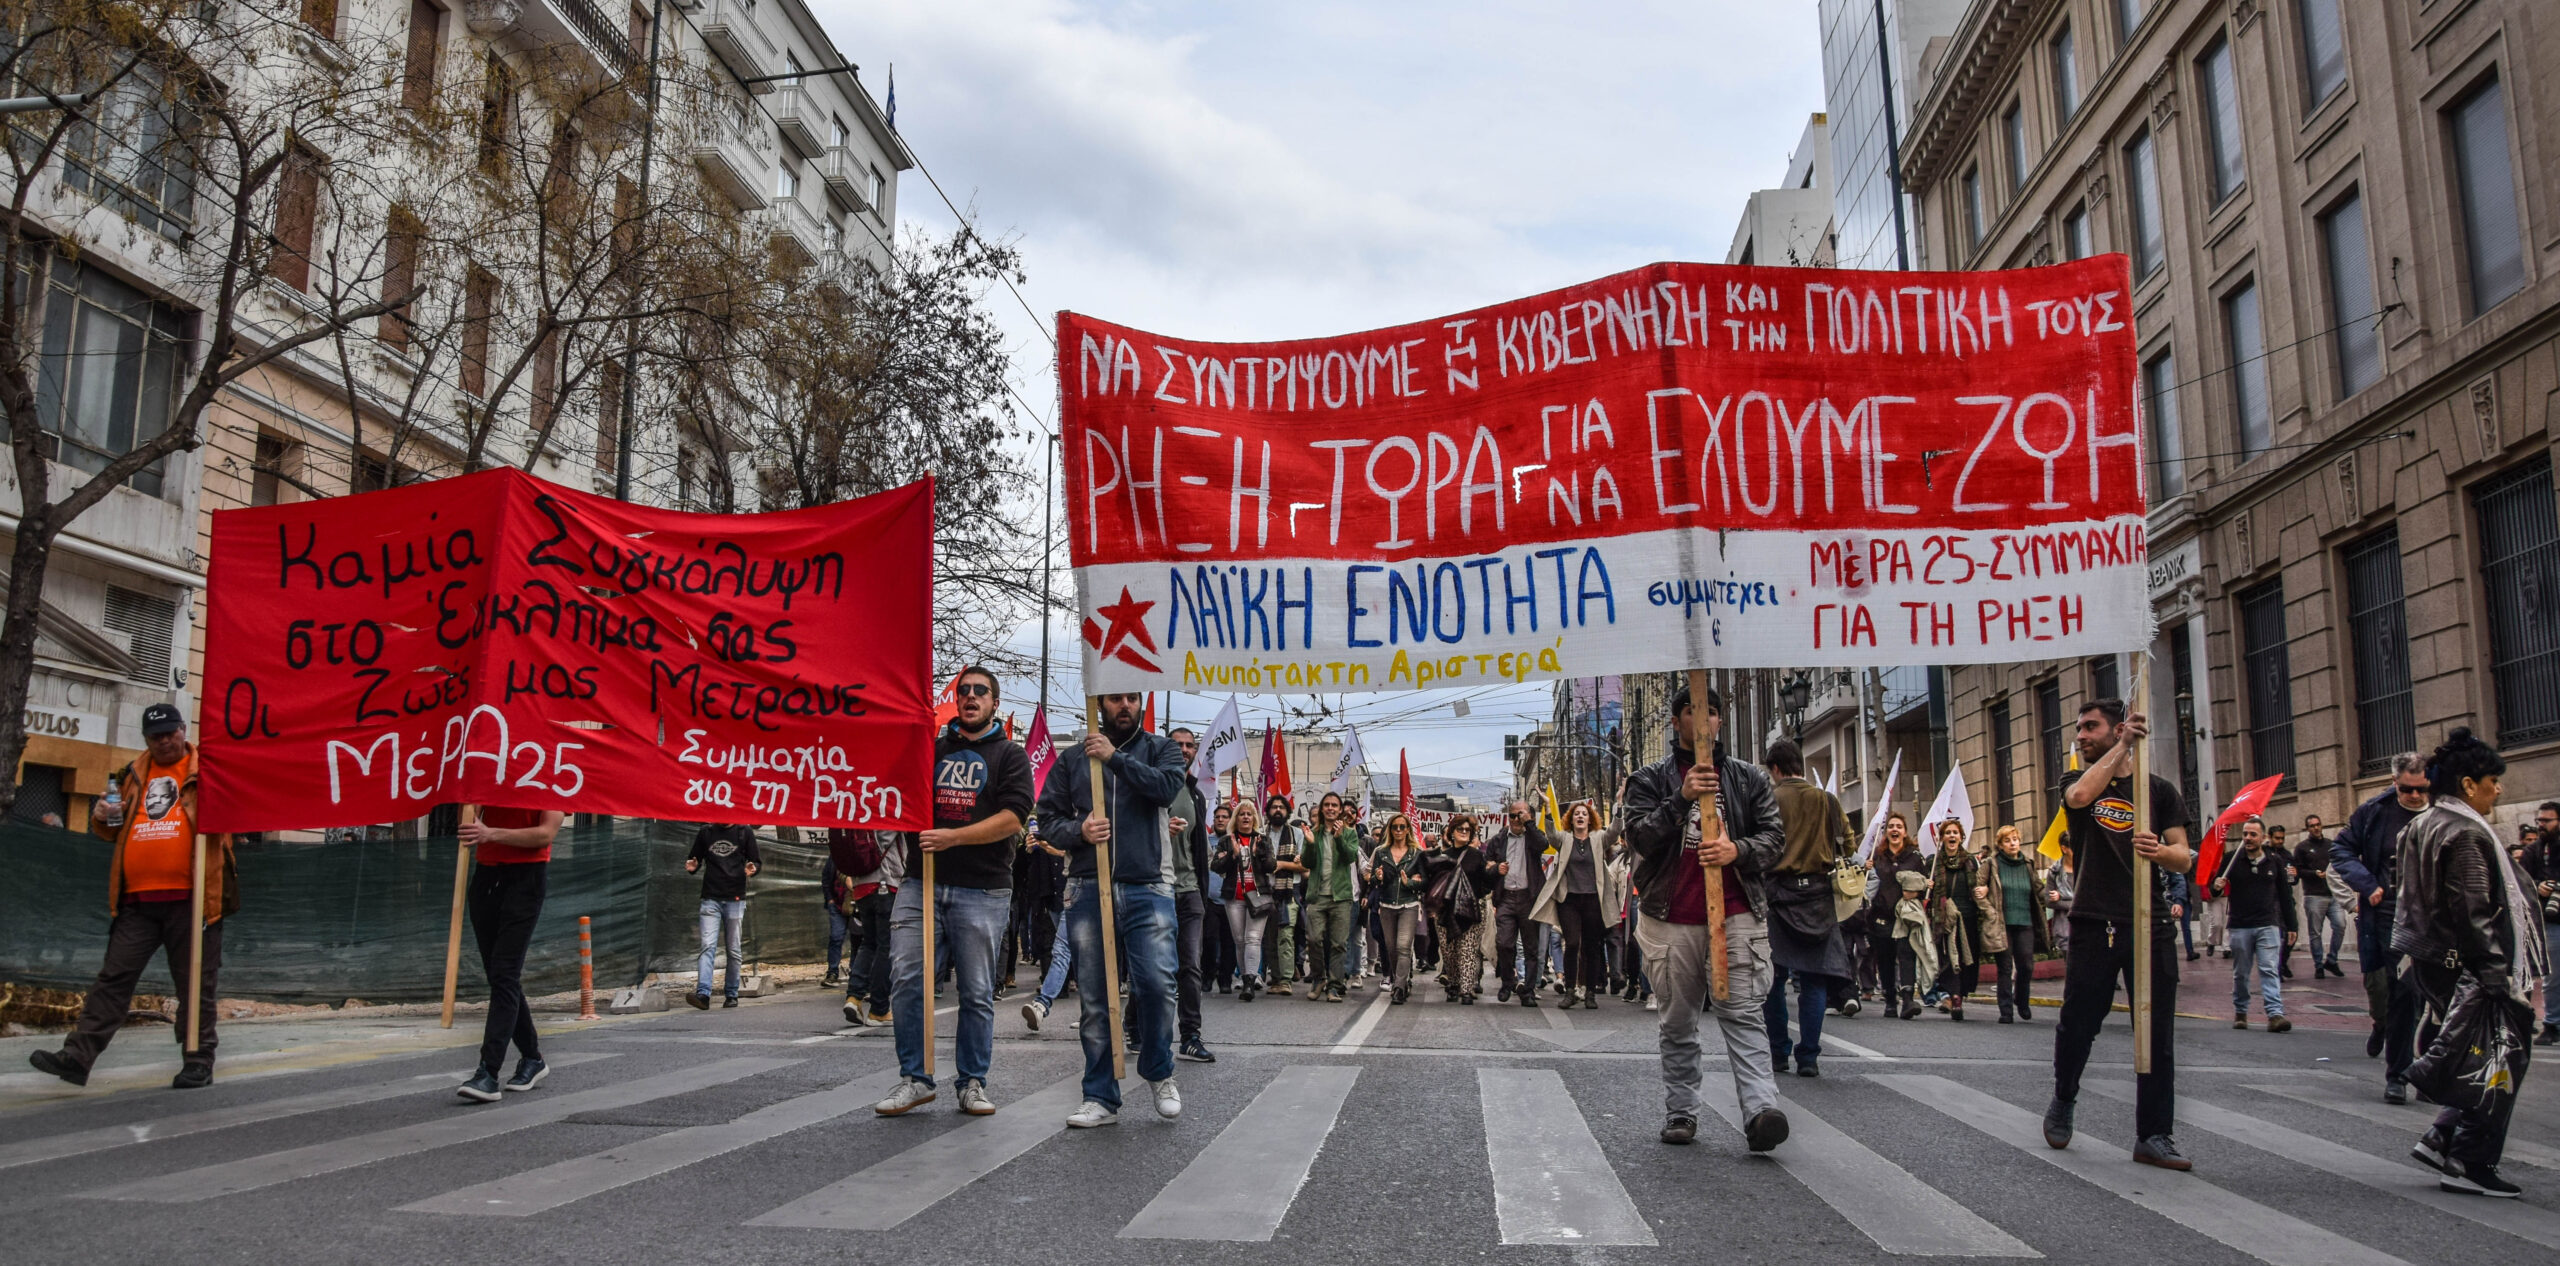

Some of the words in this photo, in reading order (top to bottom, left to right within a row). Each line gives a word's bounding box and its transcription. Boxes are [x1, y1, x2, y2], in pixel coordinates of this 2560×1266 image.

[1725, 280, 1779, 313] ΚΑΙ
[1806, 282, 2013, 358] ΠΟΛΙΤΙΚΗ
[2025, 291, 2125, 339] ΤΟΥΣ
[1443, 318, 1480, 394] ΤΗΝ
[1497, 281, 1708, 378] ΚΥΒΕΡΝΗΣΗ
[1723, 319, 1787, 352] ΤΗΝ
[1081, 330, 1141, 399] ΝΑ
[1154, 338, 1426, 412] ΣΥΝΤΡΙΨΟΥΜΕ
[1541, 397, 1614, 461] ΓΙΑ
[1645, 387, 1919, 517] ΕΧΟΥΜΕ
[1952, 375, 2144, 513] ΖΩΗ
[1086, 425, 1272, 555] ΡΗΞΗ
[1309, 425, 1505, 550] ΤΩΡΑ
[1547, 466, 1624, 527] ΝΑ
[278, 512, 484, 599] Καμία
[527, 494, 845, 611] Συγκάλυψη
[2154, 554, 2186, 588] BANK
[1167, 564, 1313, 652] ΛΑΪΚΗ
[1346, 545, 1616, 649] ΕΝΟΤΗΤΑ
[1813, 603, 1877, 649] ΓΙΑ
[1900, 600, 1954, 646] ΤΗ
[1978, 594, 2083, 645] ΡΗΞΗ
[286, 618, 384, 669] στο
[705, 611, 797, 664] σας
[1183, 650, 1370, 689] Ανυπότακτη
[1388, 636, 1564, 690] Αριστερά
[224, 676, 281, 741] Οι
[352, 667, 471, 723] Ζωές
[504, 660, 599, 704] μας
[650, 659, 868, 732] Μετράνε
[678, 729, 854, 781] Συμμαχία
[936, 759, 984, 789] Z&C
[683, 778, 735, 807] για
[750, 779, 790, 815] τη
[812, 774, 902, 824] Ρήξη
[2094, 806, 2134, 821] Dickie
